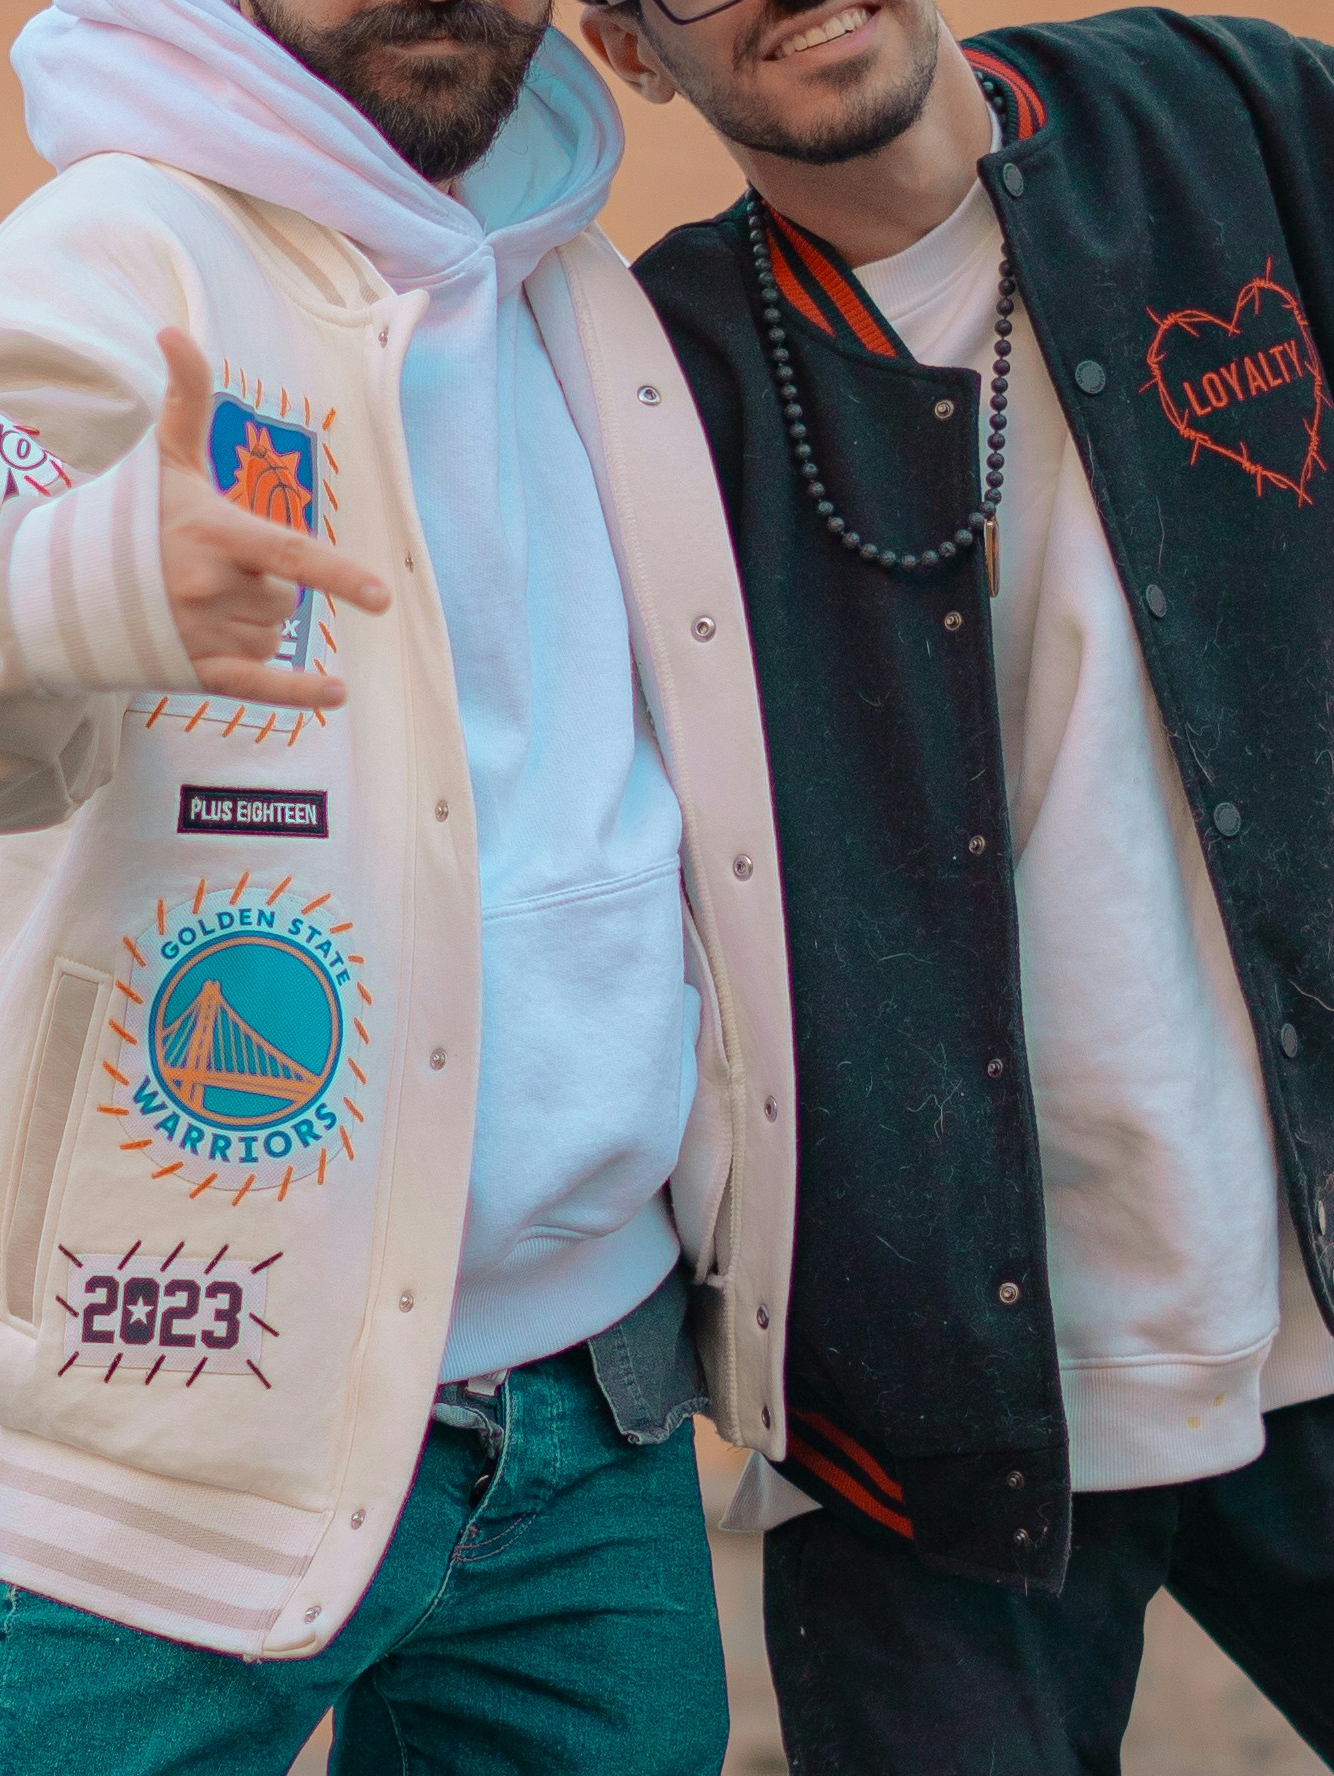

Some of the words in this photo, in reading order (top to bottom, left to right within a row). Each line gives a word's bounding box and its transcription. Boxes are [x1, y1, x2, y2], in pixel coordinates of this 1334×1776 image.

[1182, 339, 1303, 417] LOYALTY
[190, 796, 233, 822] PLUS
[236, 800, 317, 826] EIGHTEEN
[160, 908, 276, 960] GOLDEN
[288, 917, 351, 987] STATE
[132, 1075, 338, 1164] WARRIORS
[81, 1275, 244, 1350] 2023
